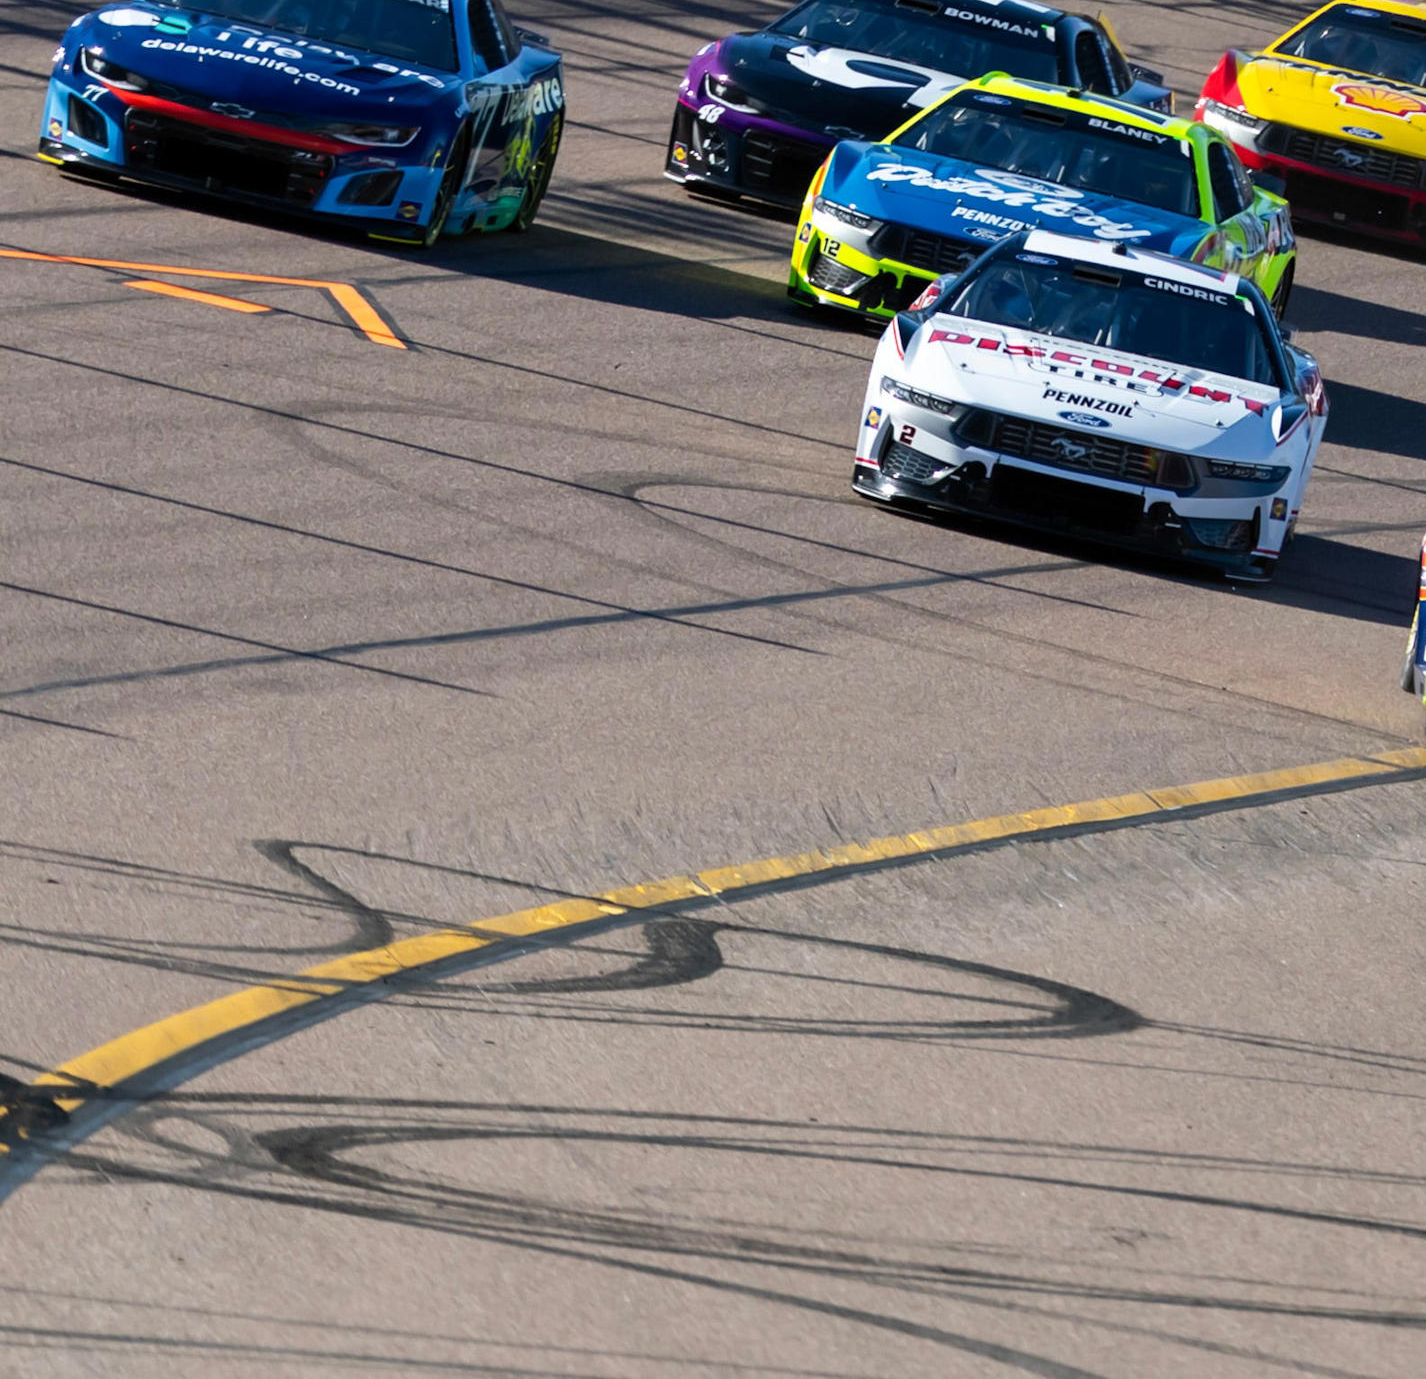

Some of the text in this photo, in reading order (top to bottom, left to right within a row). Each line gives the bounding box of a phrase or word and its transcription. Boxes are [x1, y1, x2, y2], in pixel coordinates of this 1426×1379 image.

[943, 7, 1039, 38] BOWMAN
[141, 38, 361, 97] delawarelife.com
[82, 84, 109, 101] 77
[698, 104, 725, 123] 48
[1088, 118, 1168, 144] BLANEY
[822, 236, 841, 258] 12
[1143, 276, 1228, 306] CINDRIC
[928, 328, 1271, 417] DISCOUNT
[1045, 364, 1149, 394] TIRE
[1042, 387, 1134, 419] PENNZOIL
[900, 425, 916, 445] 2
